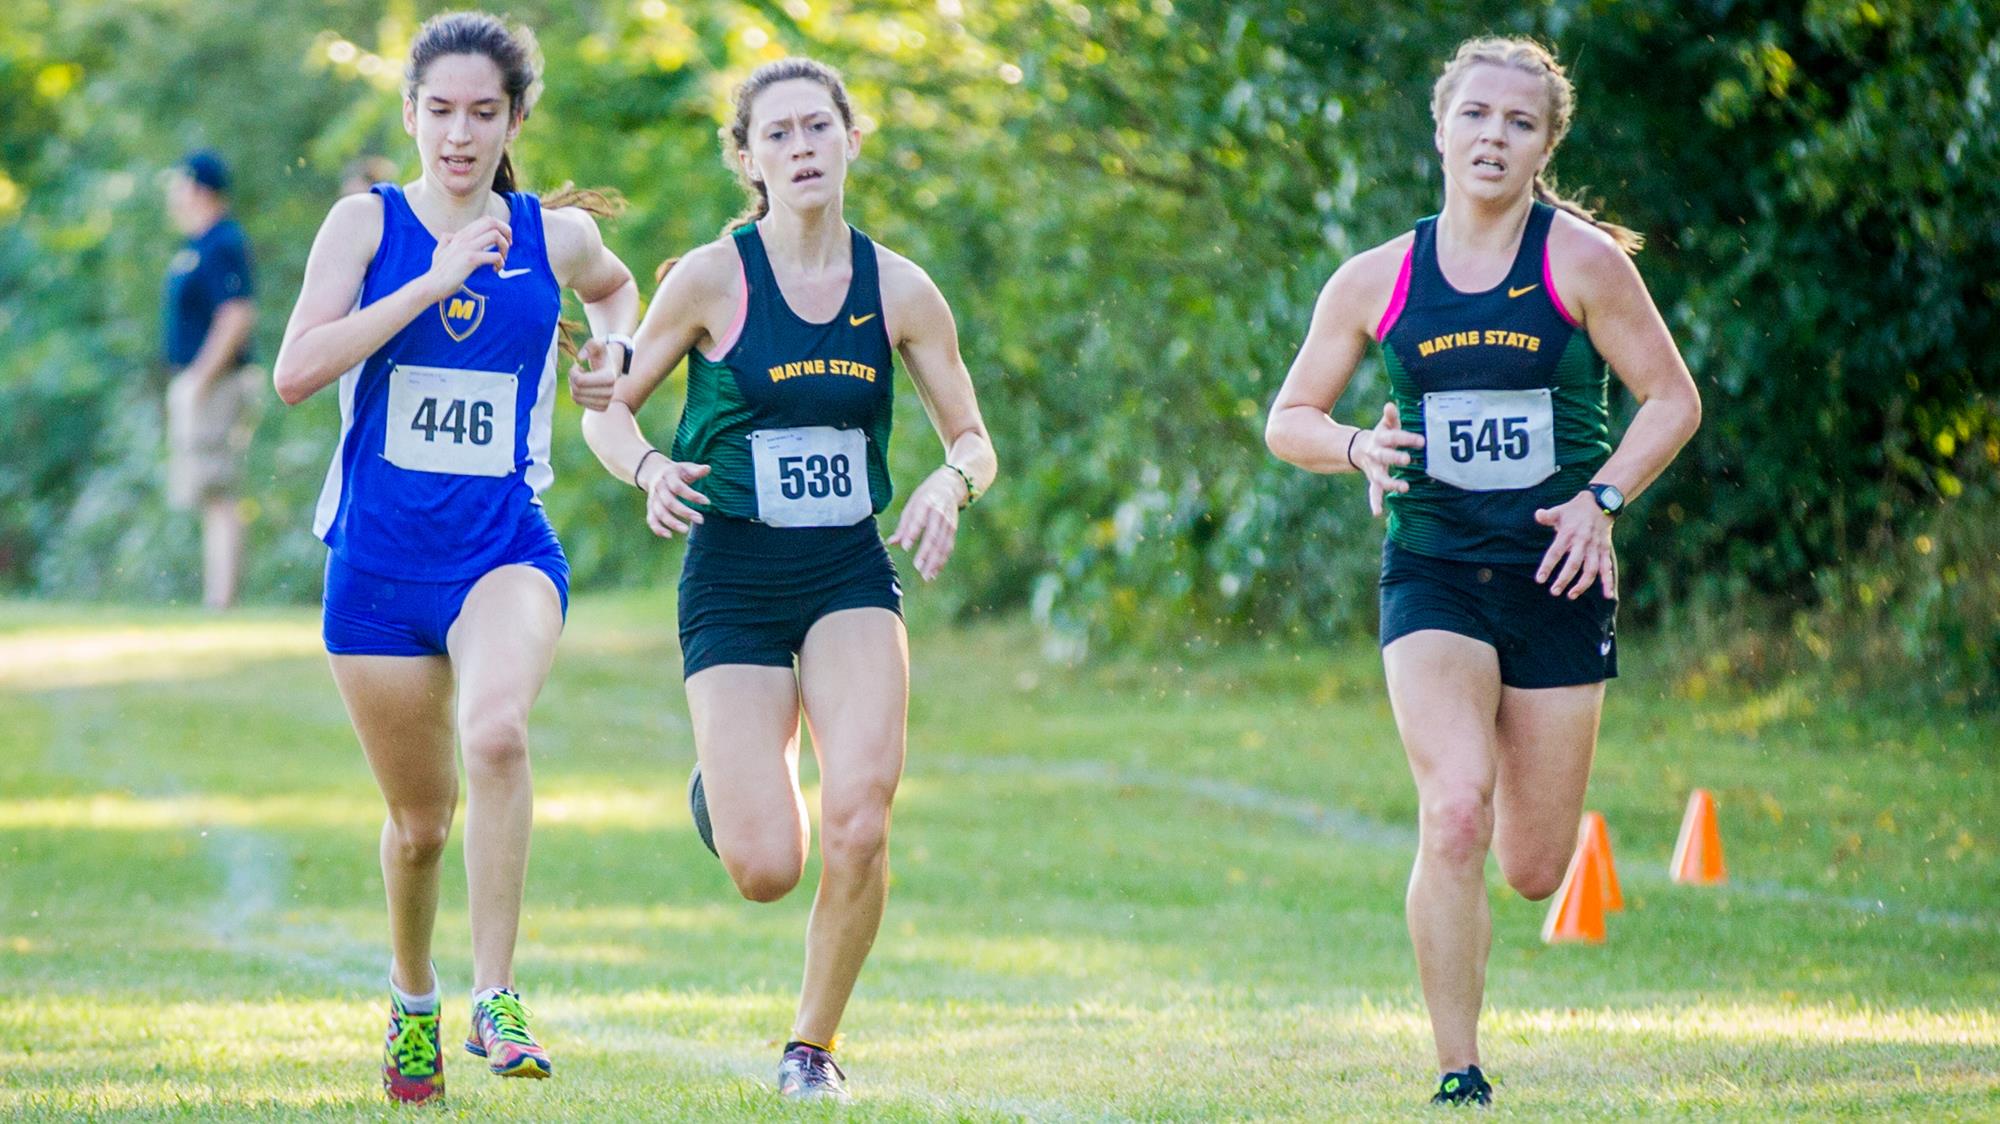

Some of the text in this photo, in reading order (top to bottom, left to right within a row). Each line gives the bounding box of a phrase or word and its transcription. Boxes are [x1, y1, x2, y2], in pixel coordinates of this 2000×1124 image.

[448, 298, 475, 320] M
[1418, 330, 1541, 357] WAYNE STATE
[768, 359, 877, 383] WAYNE STATE
[411, 397, 494, 446] 446
[1448, 416, 1531, 463] 545
[778, 453, 853, 500] 538
